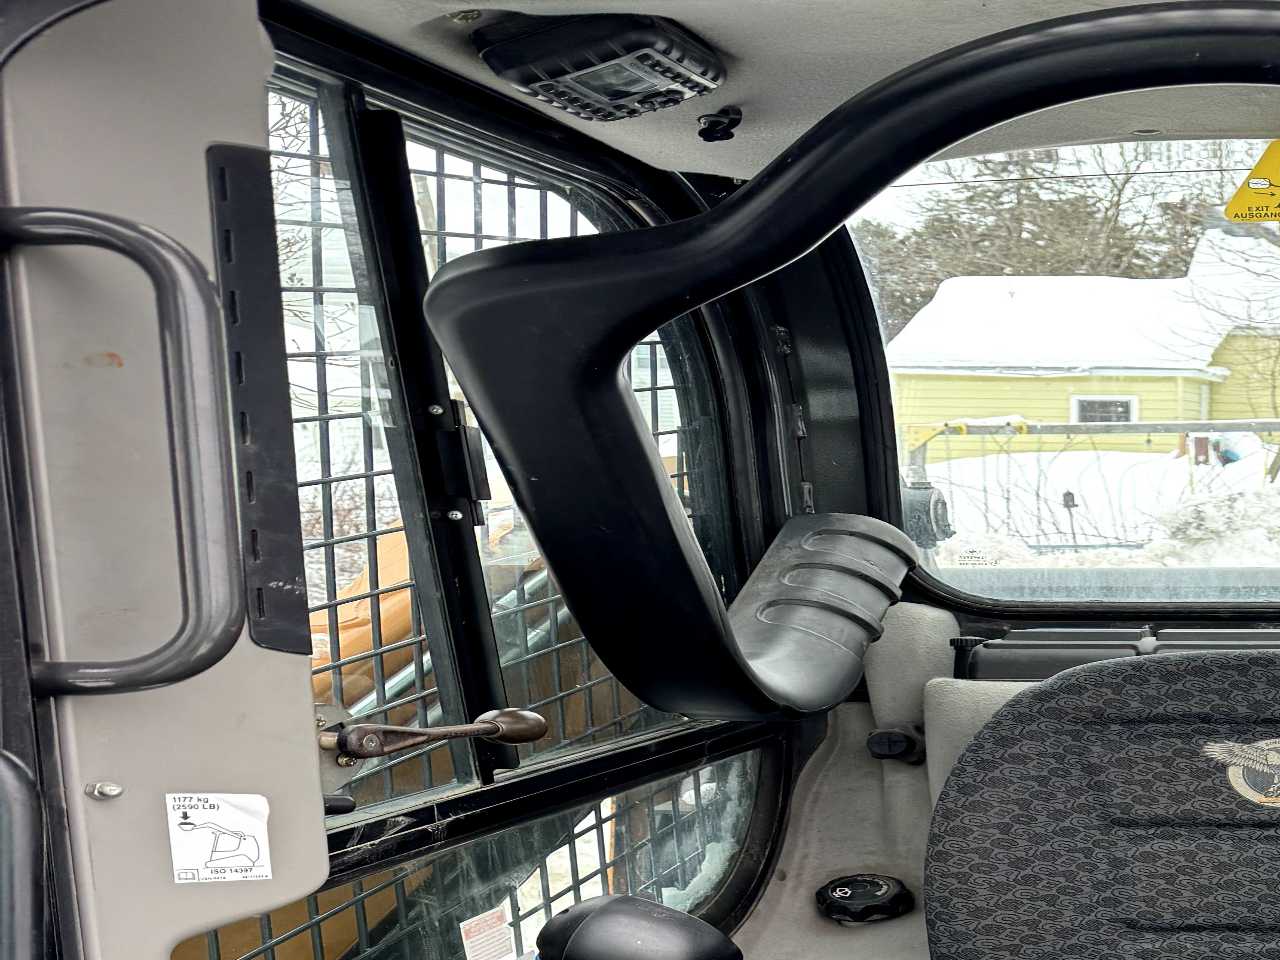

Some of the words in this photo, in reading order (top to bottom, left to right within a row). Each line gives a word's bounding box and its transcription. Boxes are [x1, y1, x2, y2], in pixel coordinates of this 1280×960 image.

[196, 796, 209, 804] kg
[172, 803, 199, 812] (2590
[202, 803, 220, 812] LB)
